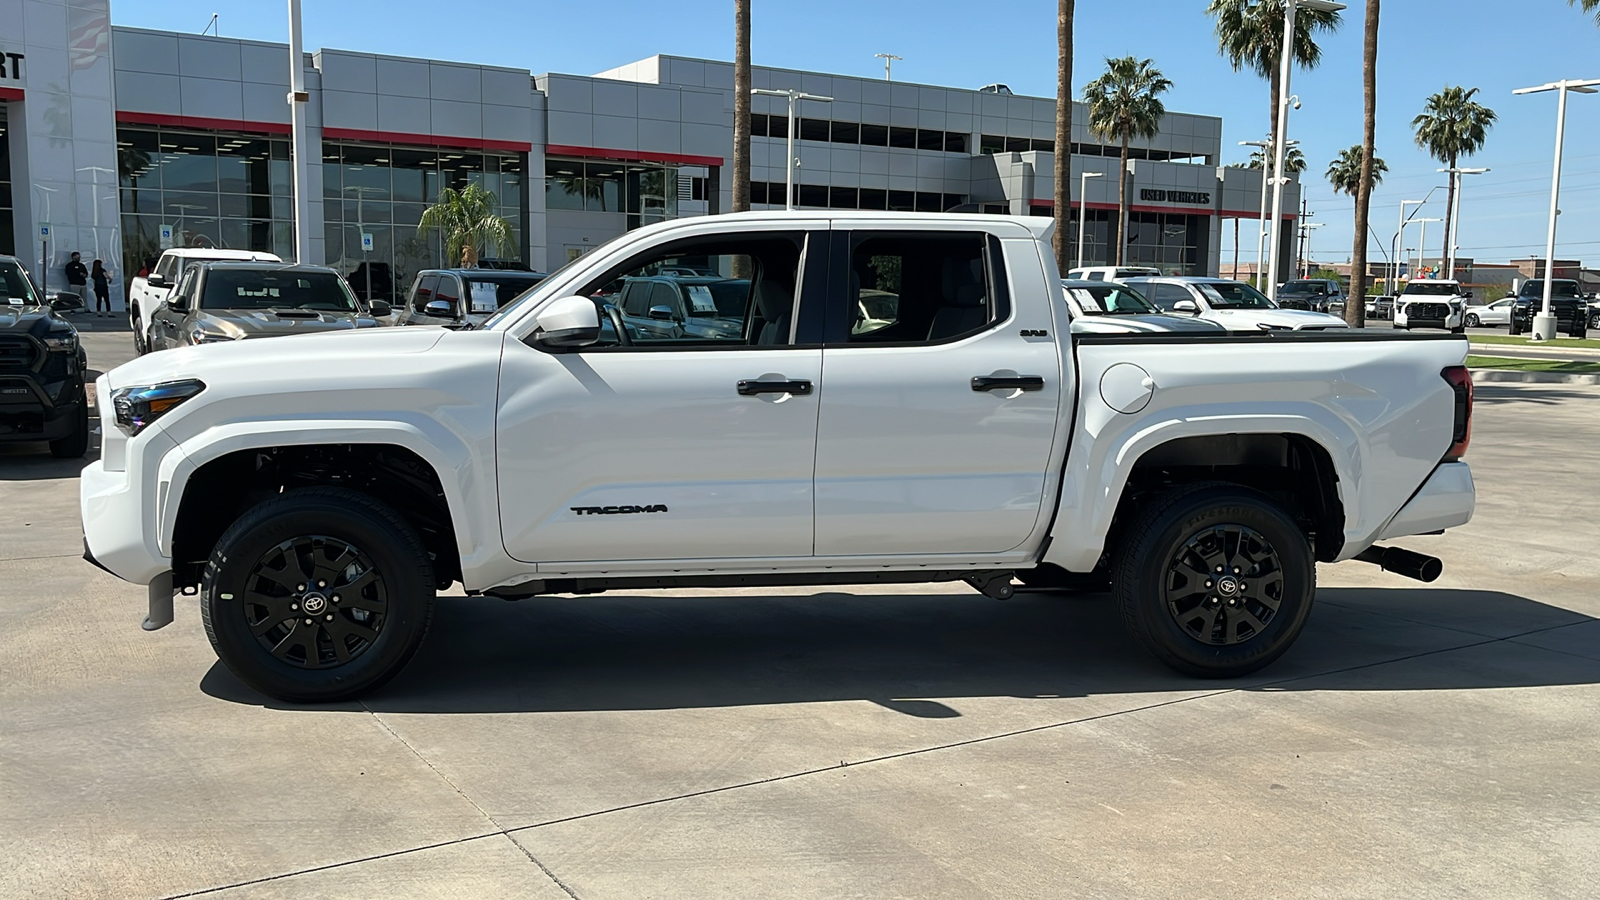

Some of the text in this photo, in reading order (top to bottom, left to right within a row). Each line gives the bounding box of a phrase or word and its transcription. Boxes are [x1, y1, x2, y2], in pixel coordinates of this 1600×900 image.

[1140, 188, 1210, 204] USED VEHICLES
[570, 504, 668, 515] TACOMA
